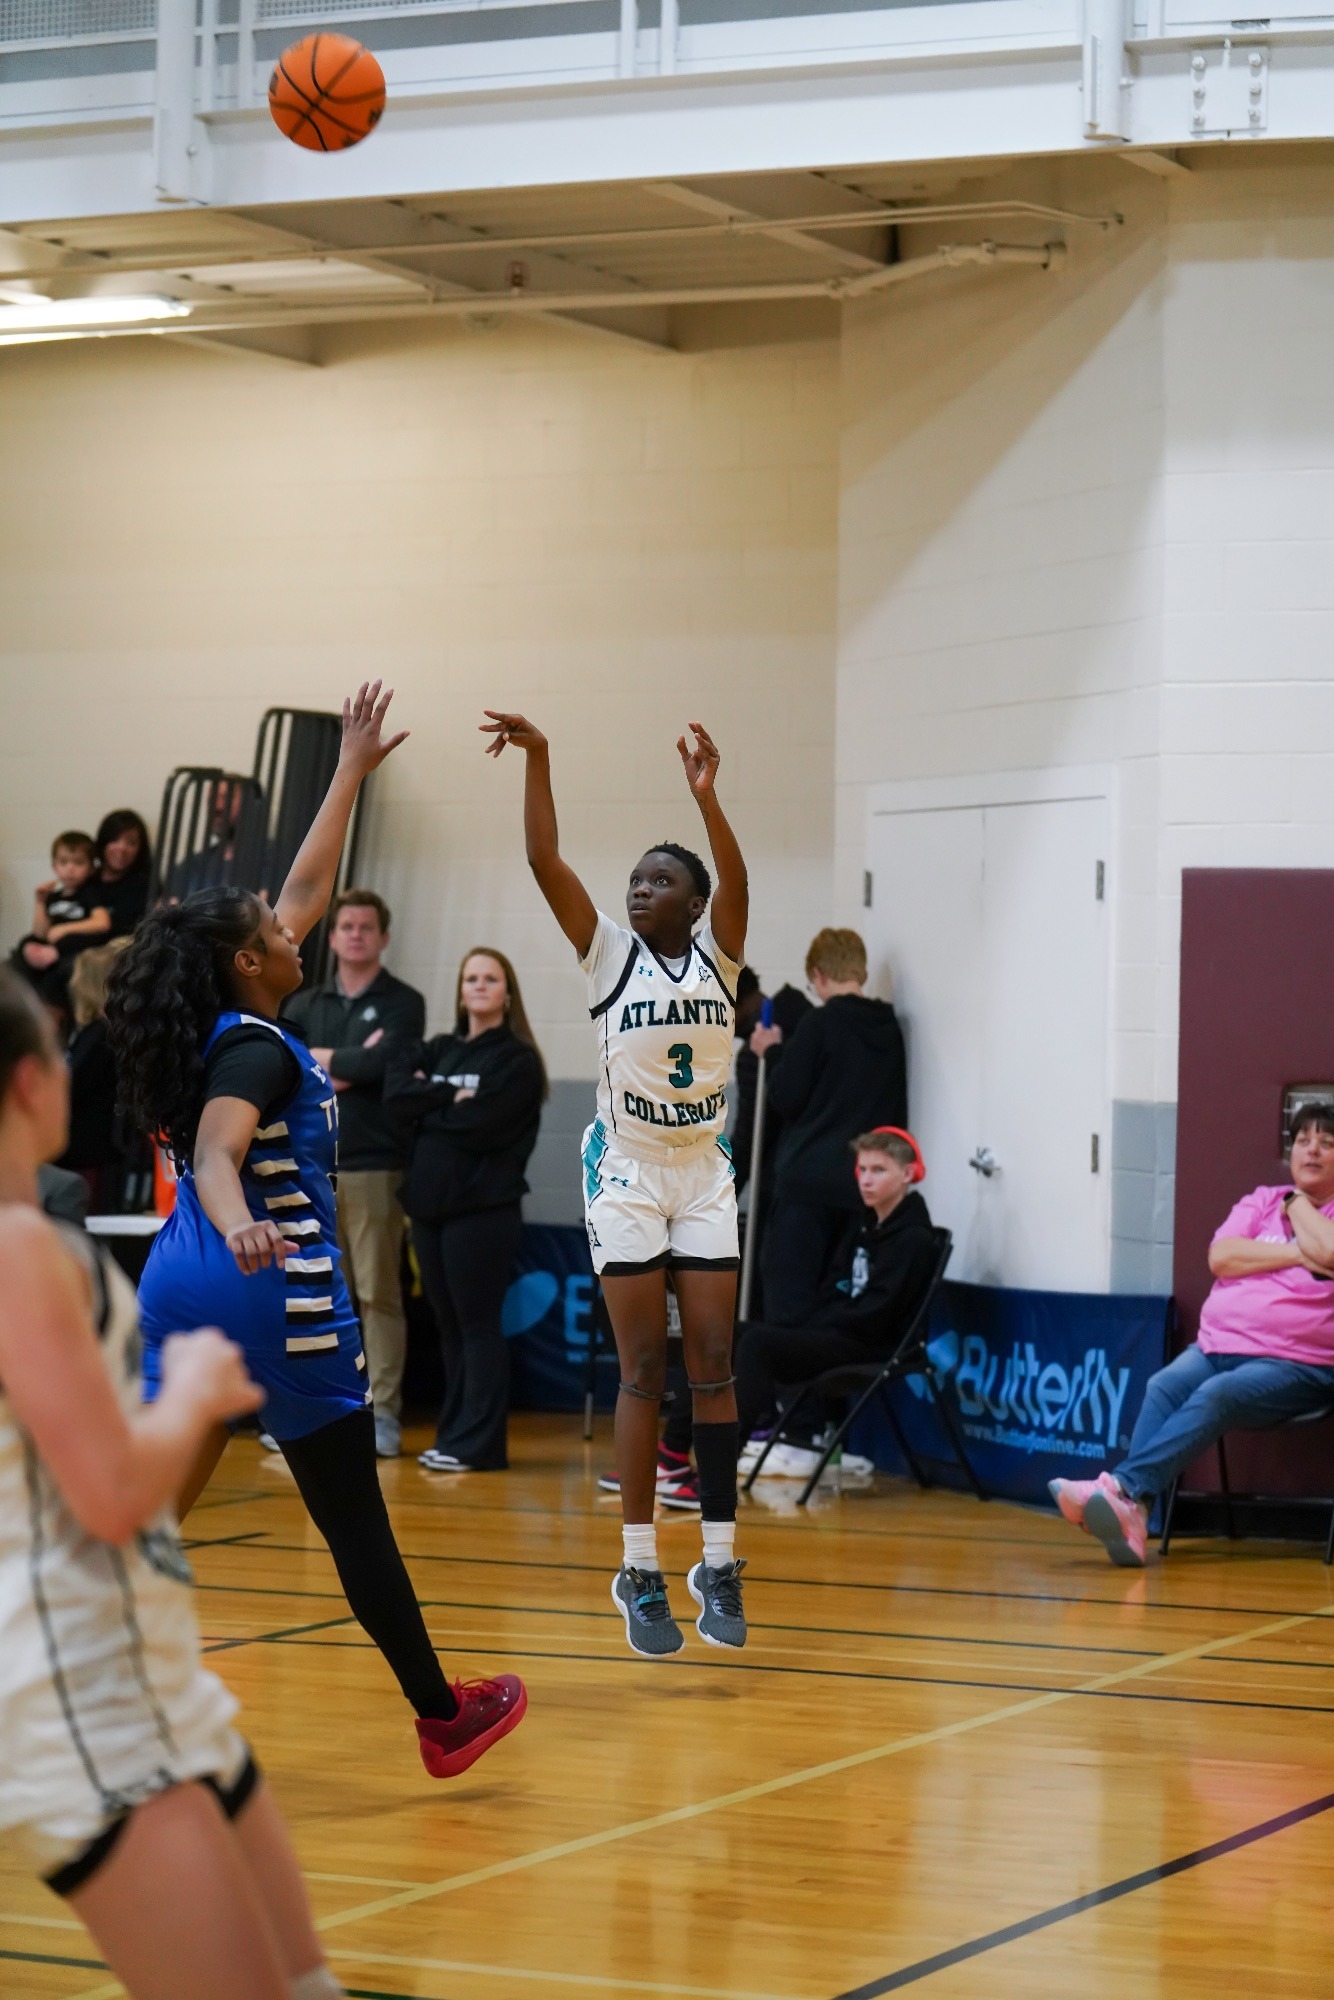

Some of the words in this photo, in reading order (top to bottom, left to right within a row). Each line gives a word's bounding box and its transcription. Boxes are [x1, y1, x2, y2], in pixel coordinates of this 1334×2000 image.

[619, 999, 728, 1033] ATLANTIC
[668, 1043, 694, 1089] 3
[956, 1335, 1130, 1448] Butterfly
